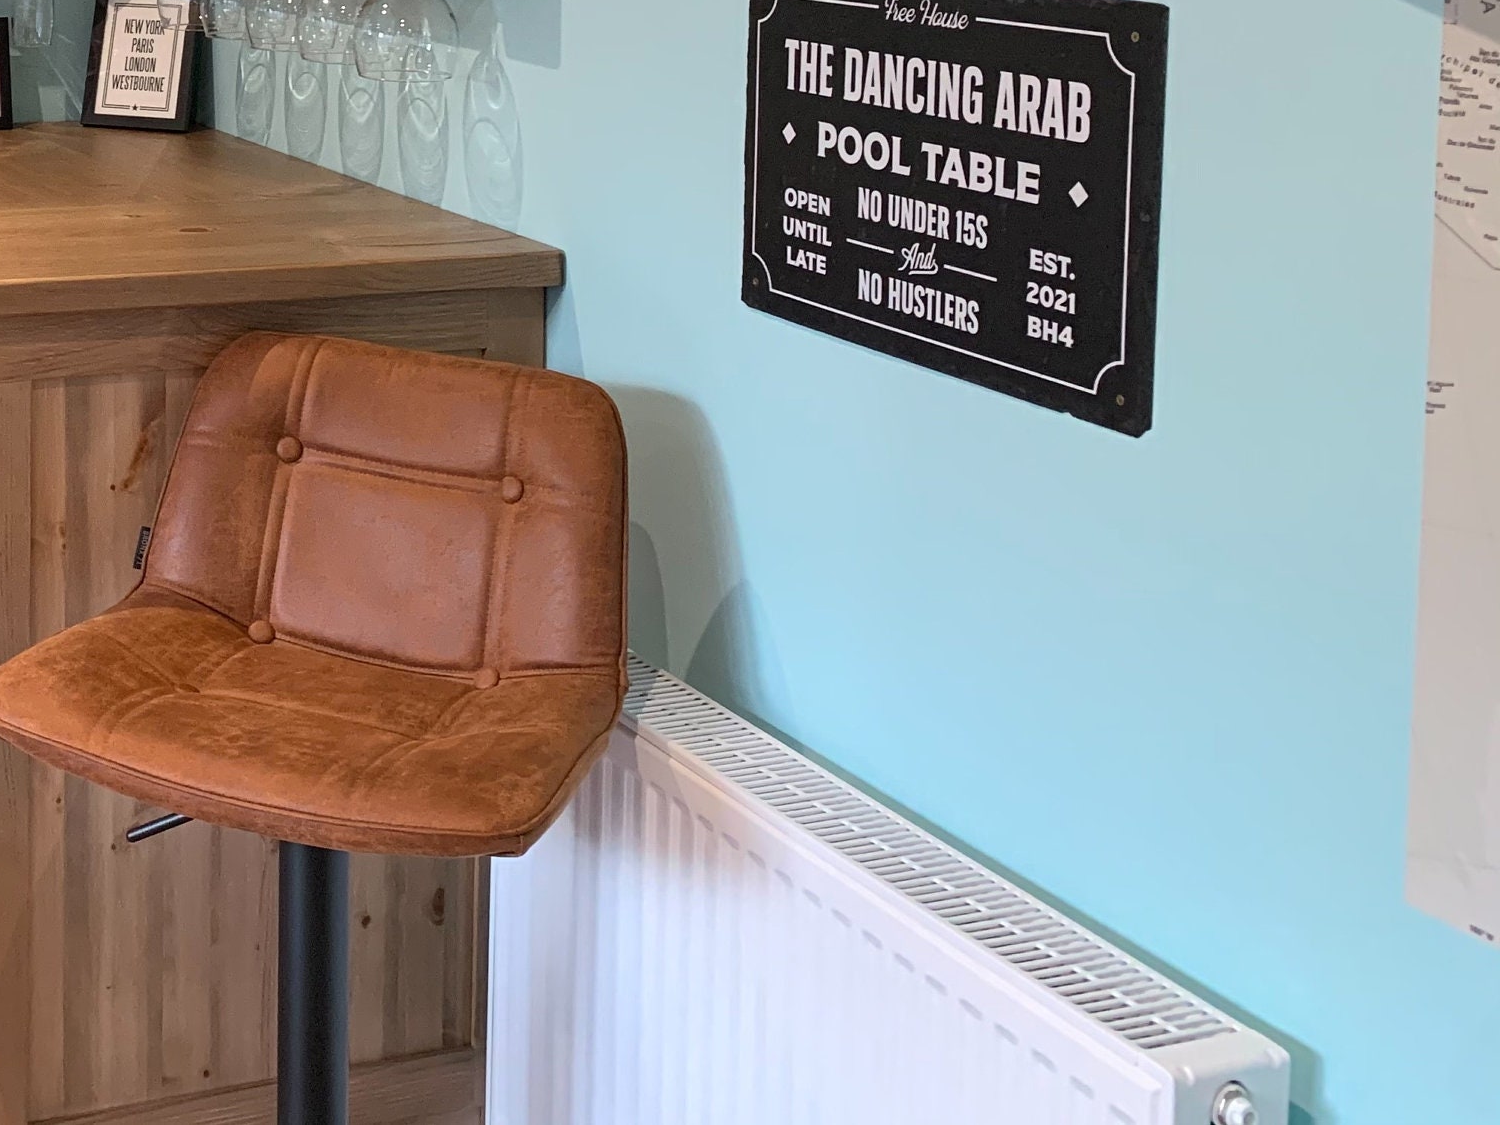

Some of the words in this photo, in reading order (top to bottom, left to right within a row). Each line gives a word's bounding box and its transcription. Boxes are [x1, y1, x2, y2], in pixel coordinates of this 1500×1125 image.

[124, 18, 144, 35] NEW
[145, 19, 165, 36] YORK
[131, 37, 155, 53] PARIS
[124, 56, 157, 73] LONDON
[112, 74, 166, 93] WESTBOURNE
[784, 37, 834, 97] THE
[844, 46, 984, 126] DANCING
[993, 70, 1092, 143] ARAB
[817, 120, 911, 177] POOL
[921, 141, 1041, 205] TABLE
[784, 187, 831, 217] OPEN
[856, 186, 882, 224] NO
[887, 192, 950, 241] UNDER
[955, 208, 989, 250] 15S
[782, 215, 832, 248] UNTIL
[785, 245, 827, 275] LATE
[897, 242, 939, 275] And
[1029, 247, 1077, 281] EST.
[857, 268, 882, 304] NO
[887, 275, 980, 336] HUSTLERS
[1026, 281, 1077, 315] 2021
[1026, 315, 1075, 349] BH4
